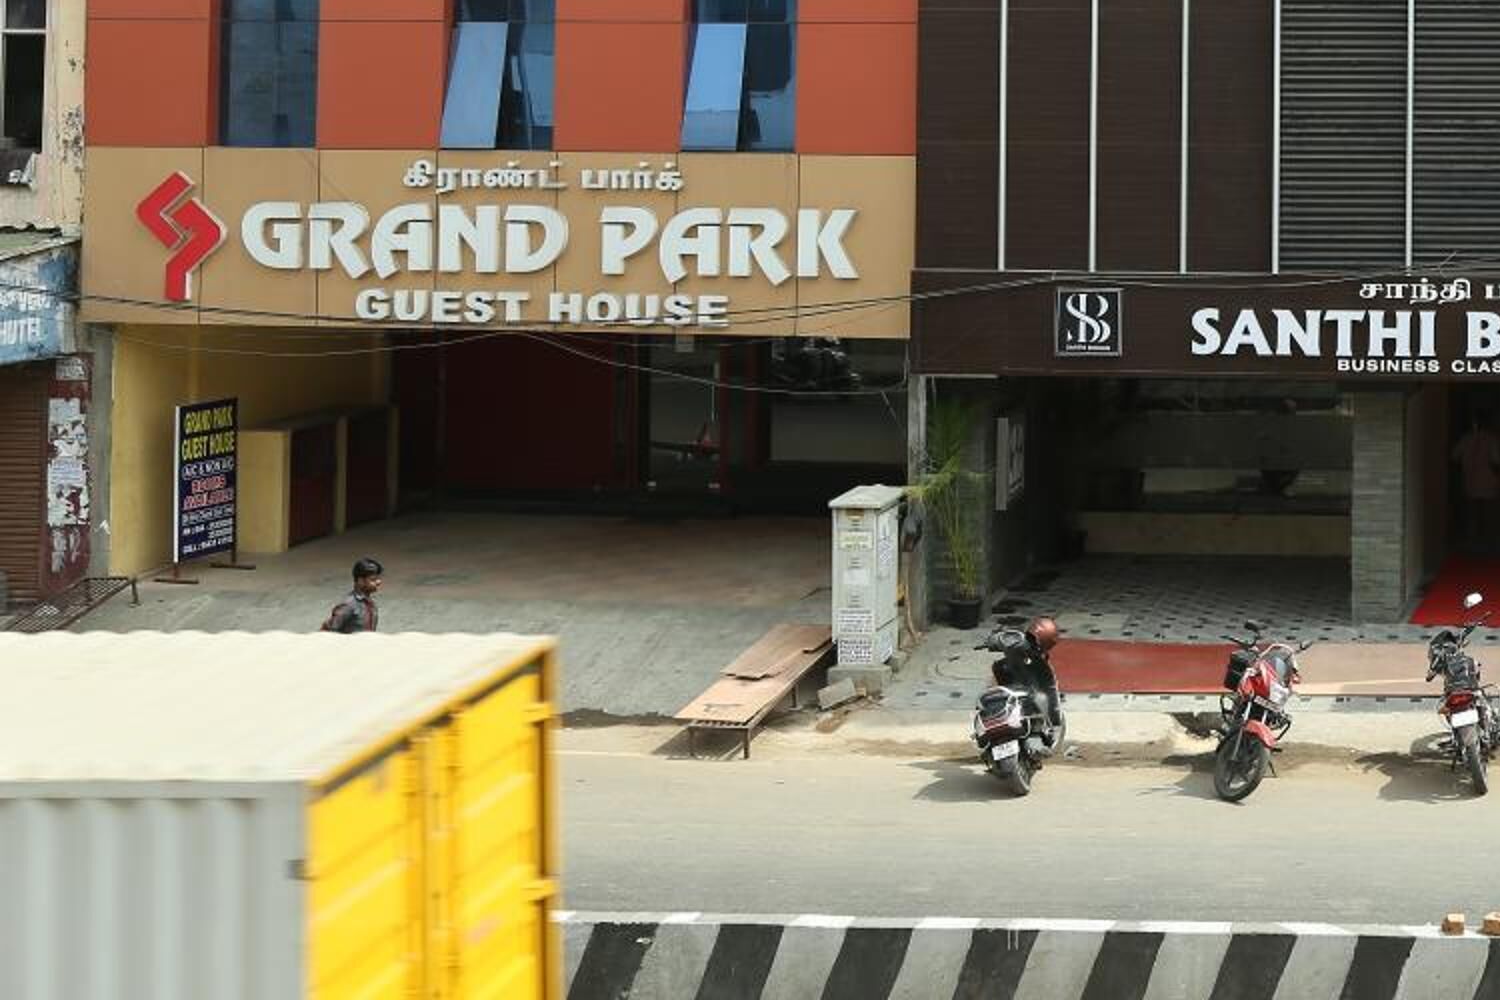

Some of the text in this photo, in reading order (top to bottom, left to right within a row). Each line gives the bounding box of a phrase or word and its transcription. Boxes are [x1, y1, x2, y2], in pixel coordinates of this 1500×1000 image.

[403, 159, 684, 194] கிராண்ட் பார்க்
[241, 201, 859, 286] GRAND PARK
[355, 288, 728, 328] GUEST HOUSE
[1359, 278, 1471, 305] சாந்தி
[1191, 308, 1436, 357] SANTHI
[1337, 358, 1440, 373] BUSINESS
[182, 435, 208, 460] GUEST
